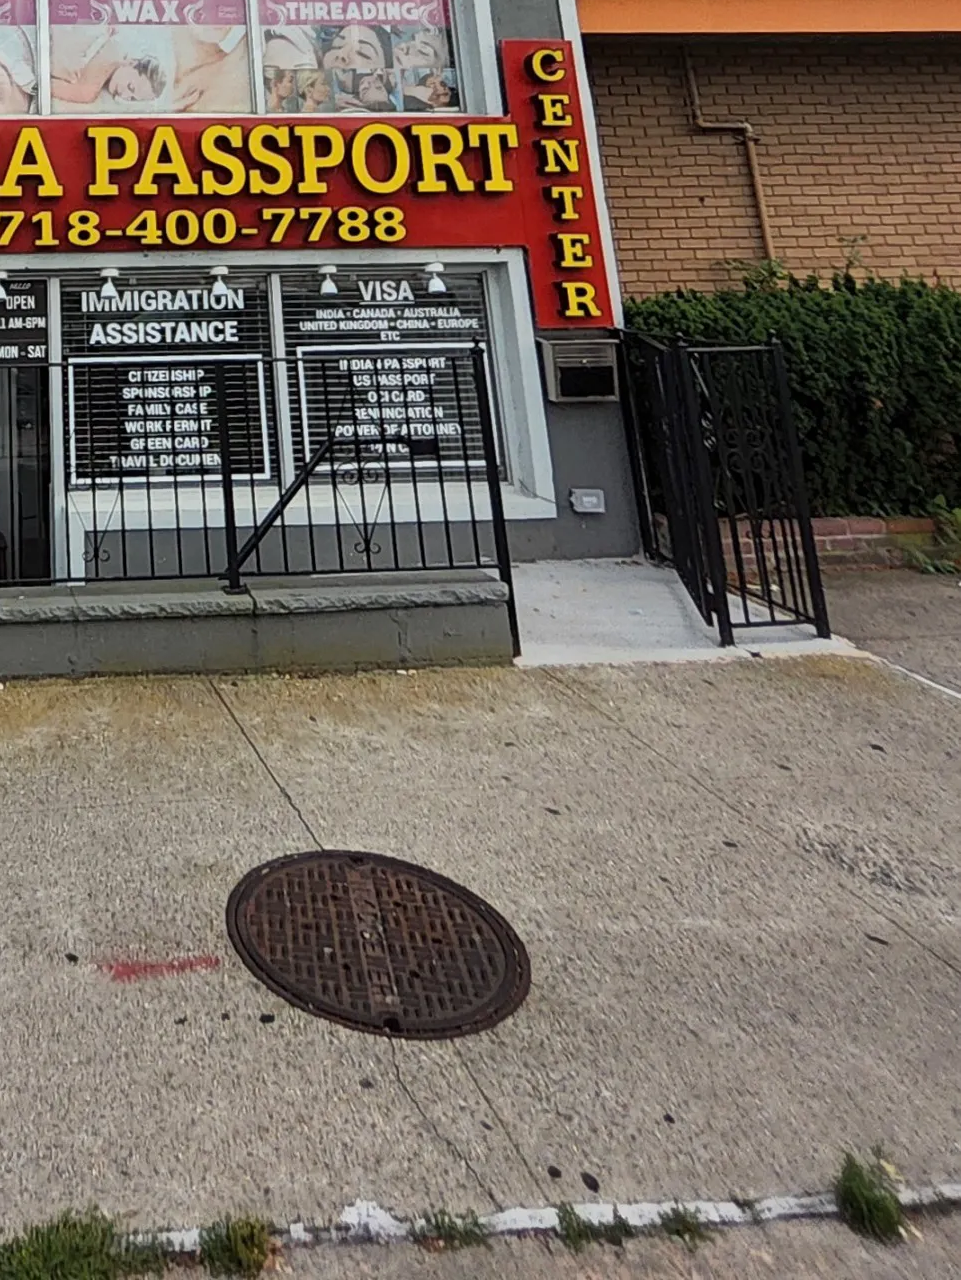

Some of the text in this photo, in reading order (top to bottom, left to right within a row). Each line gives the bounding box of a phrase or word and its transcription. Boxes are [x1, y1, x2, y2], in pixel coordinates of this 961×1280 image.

[112, 0, 181, 23] WAX
[285, 1, 420, 21] THREADING
[86, 123, 520, 198] PASSPORT
[532, 49, 601, 317] CENTER
[81, 289, 245, 312] IMMIGRATION
[358, 280, 415, 301] VISA
[6, 295, 36, 310] OPEN
[8, 316, 46, 329] AM-6PM
[316, 307, 461, 319] INDIA CANADA AUSTRALIA
[89, 321, 240, 345] ASSISTANCE
[299, 318, 479, 331] UNITED KINGDOM CHINA EUROPE
[380, 331, 401, 341] ETC
[27, 345, 47, 359] SAT
